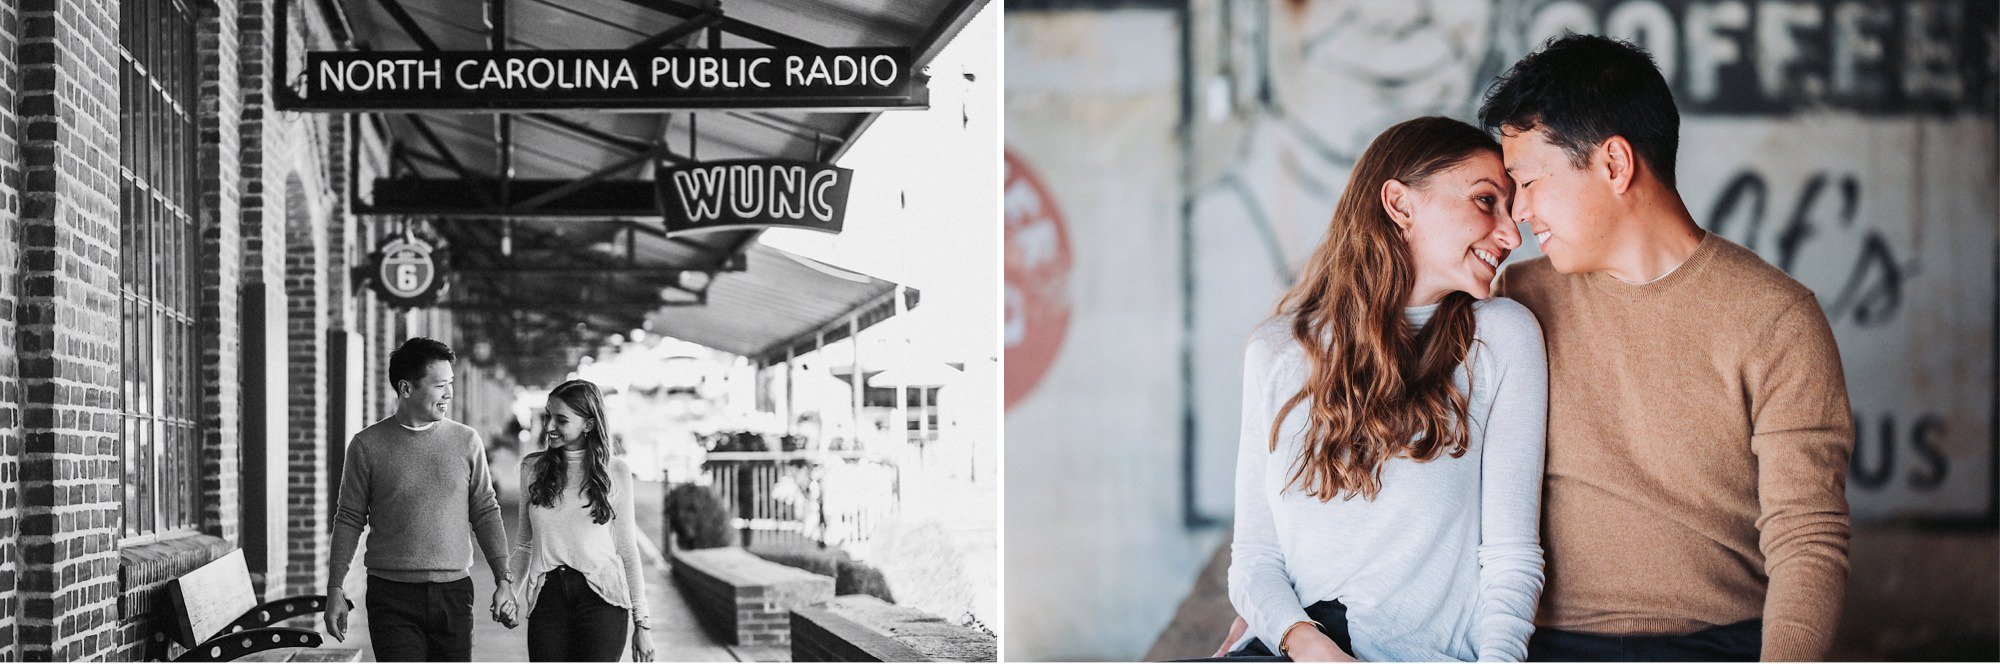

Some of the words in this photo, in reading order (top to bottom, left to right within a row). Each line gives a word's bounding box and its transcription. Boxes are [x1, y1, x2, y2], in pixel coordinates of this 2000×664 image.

[319, 58, 441, 92] NORTH
[455, 57, 639, 90] CAROLINA
[651, 56, 772, 88] PUBLIC
[785, 54, 898, 87] RADIO
[673, 164, 838, 222] WUNC
[396, 264, 418, 291] 6
